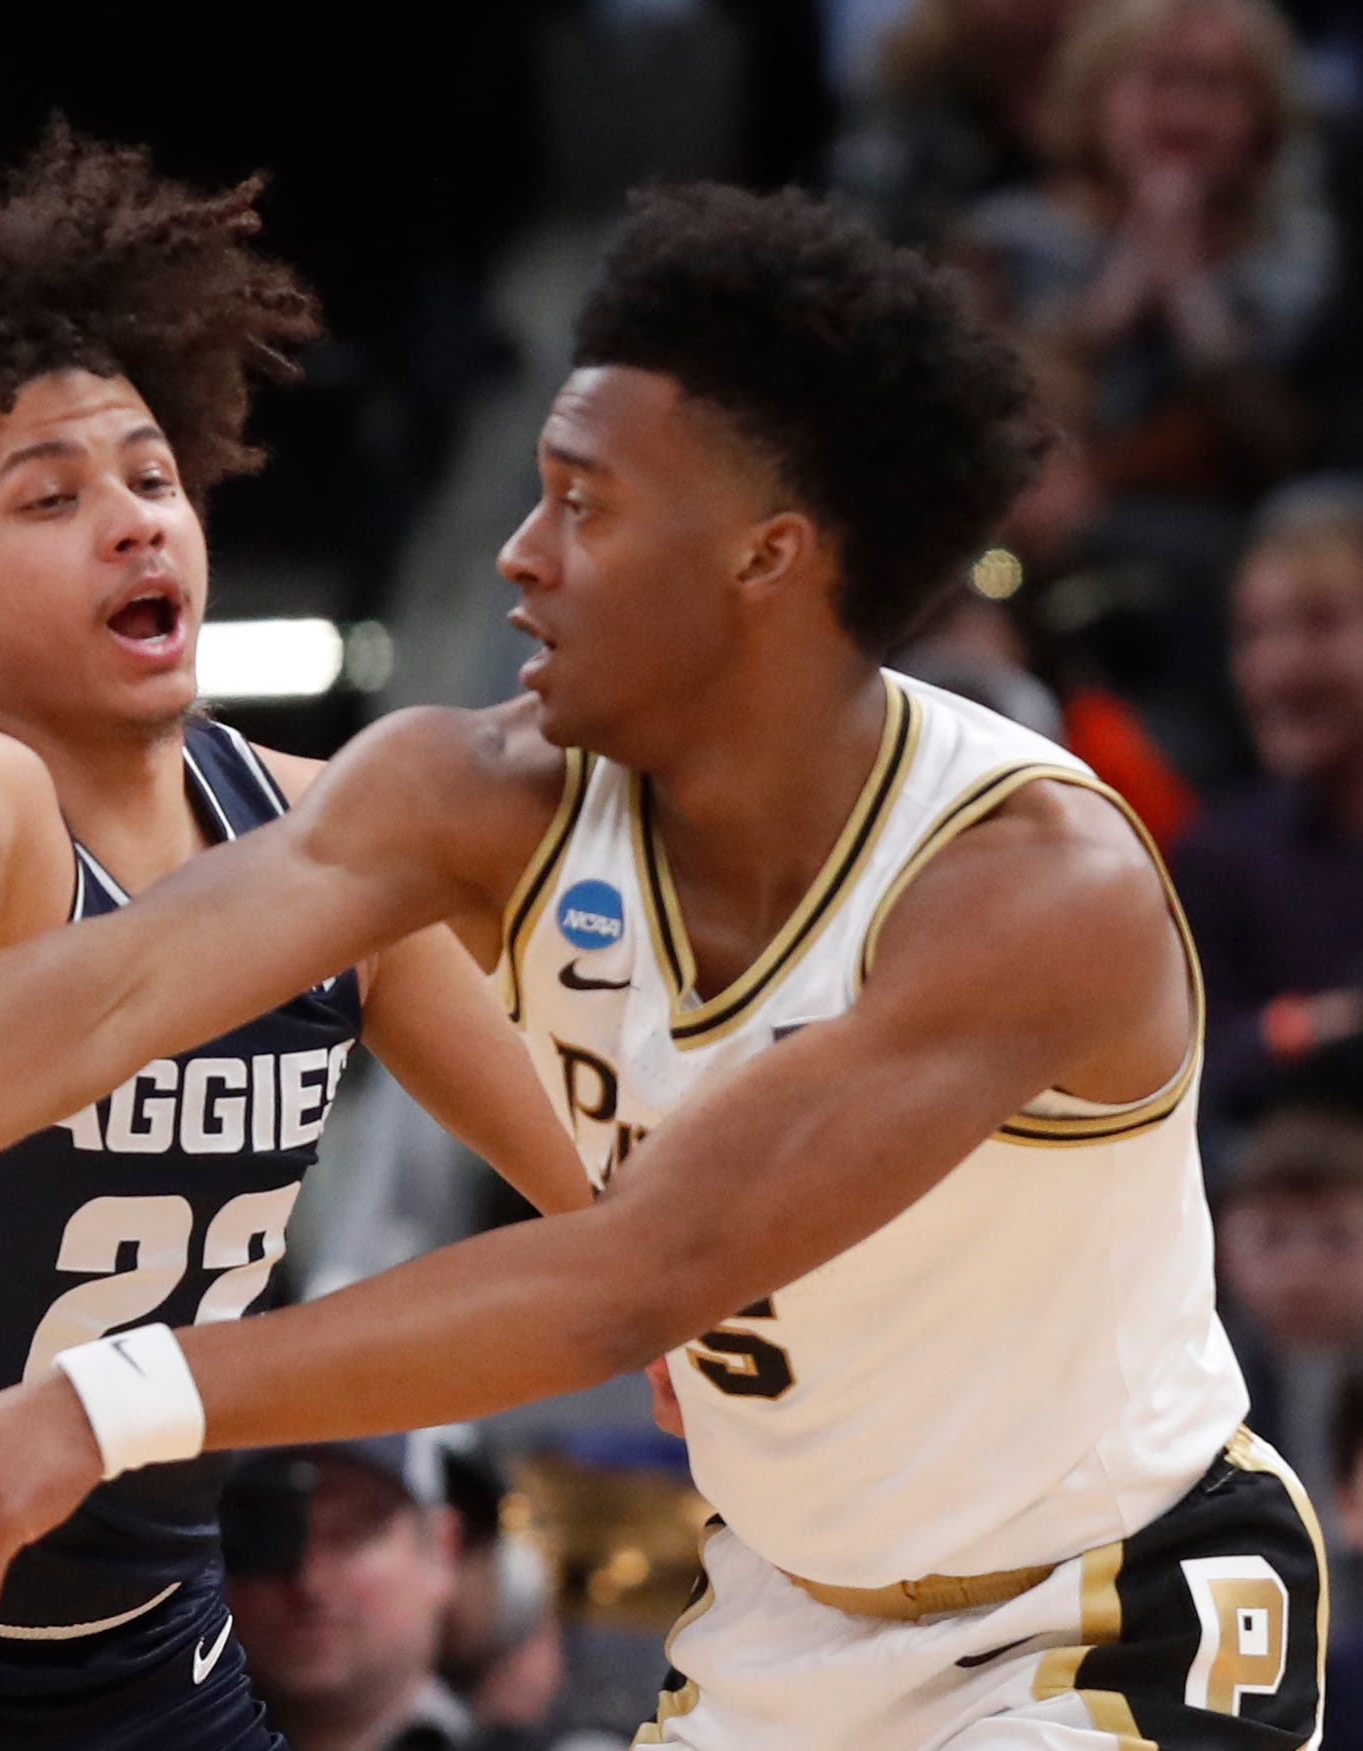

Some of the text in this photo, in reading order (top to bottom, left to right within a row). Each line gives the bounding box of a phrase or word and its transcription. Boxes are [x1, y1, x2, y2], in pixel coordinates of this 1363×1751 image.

[562, 907, 622, 937] NCAA
[22, 1180, 301, 1383] 22
[686, 1294, 796, 1402] 5
[1179, 1554, 1290, 1718] P
